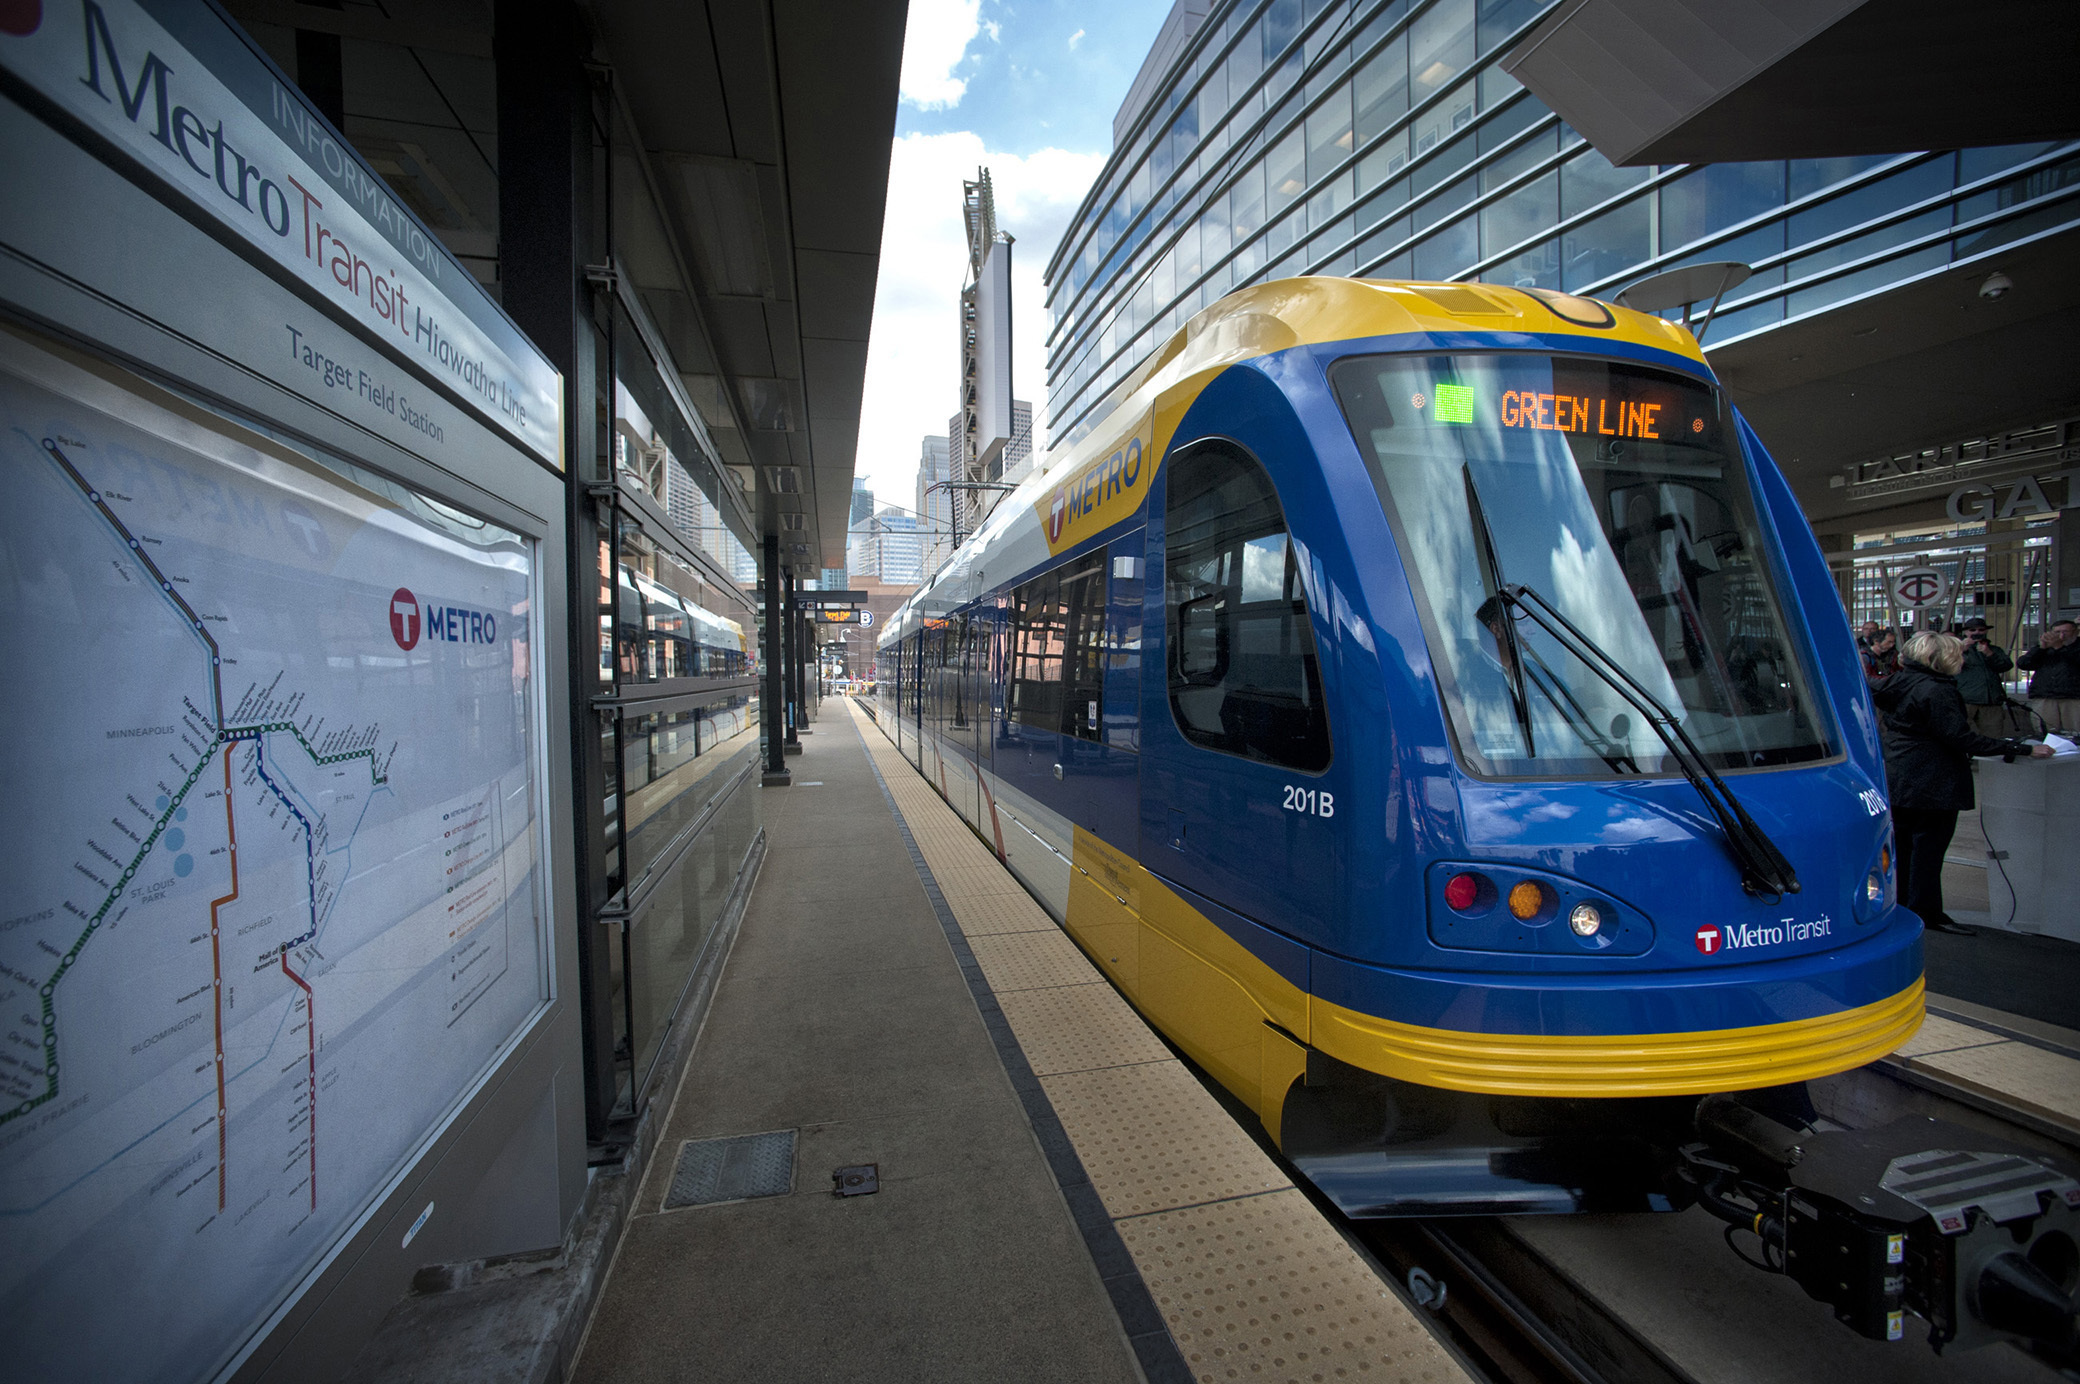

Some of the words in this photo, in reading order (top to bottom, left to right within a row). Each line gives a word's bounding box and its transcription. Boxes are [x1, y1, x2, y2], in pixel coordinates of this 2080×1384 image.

[272, 80, 441, 278] INFORMATION
[286, 324, 352, 392] Target
[358, 370, 395, 415] Field
[400, 398, 444, 444] Station
[415, 306, 498, 404] Hiawatha
[501, 380, 527, 427] Line
[1501, 389, 1588, 433] GREEN
[1598, 399, 1661, 439] LINE
[1843, 416, 2080, 486] TARGET
[1068, 437, 1142, 525] METRO
[427, 605, 496, 645] METRO
[106, 725, 176, 740] MINNEAPOLIS
[183, 695, 202, 719] Target
[201, 715, 217, 735] Field
[1283, 784, 1335, 818] 201B
[141, 890, 167, 904] PARK
[147, 877, 176, 894] LOUIS
[0, 907, 56, 933] OPKINS
[237, 916, 273, 937] RICHFIELD
[253, 957, 279, 973] America
[130, 1011, 203, 1056] BLOOMINGTON
